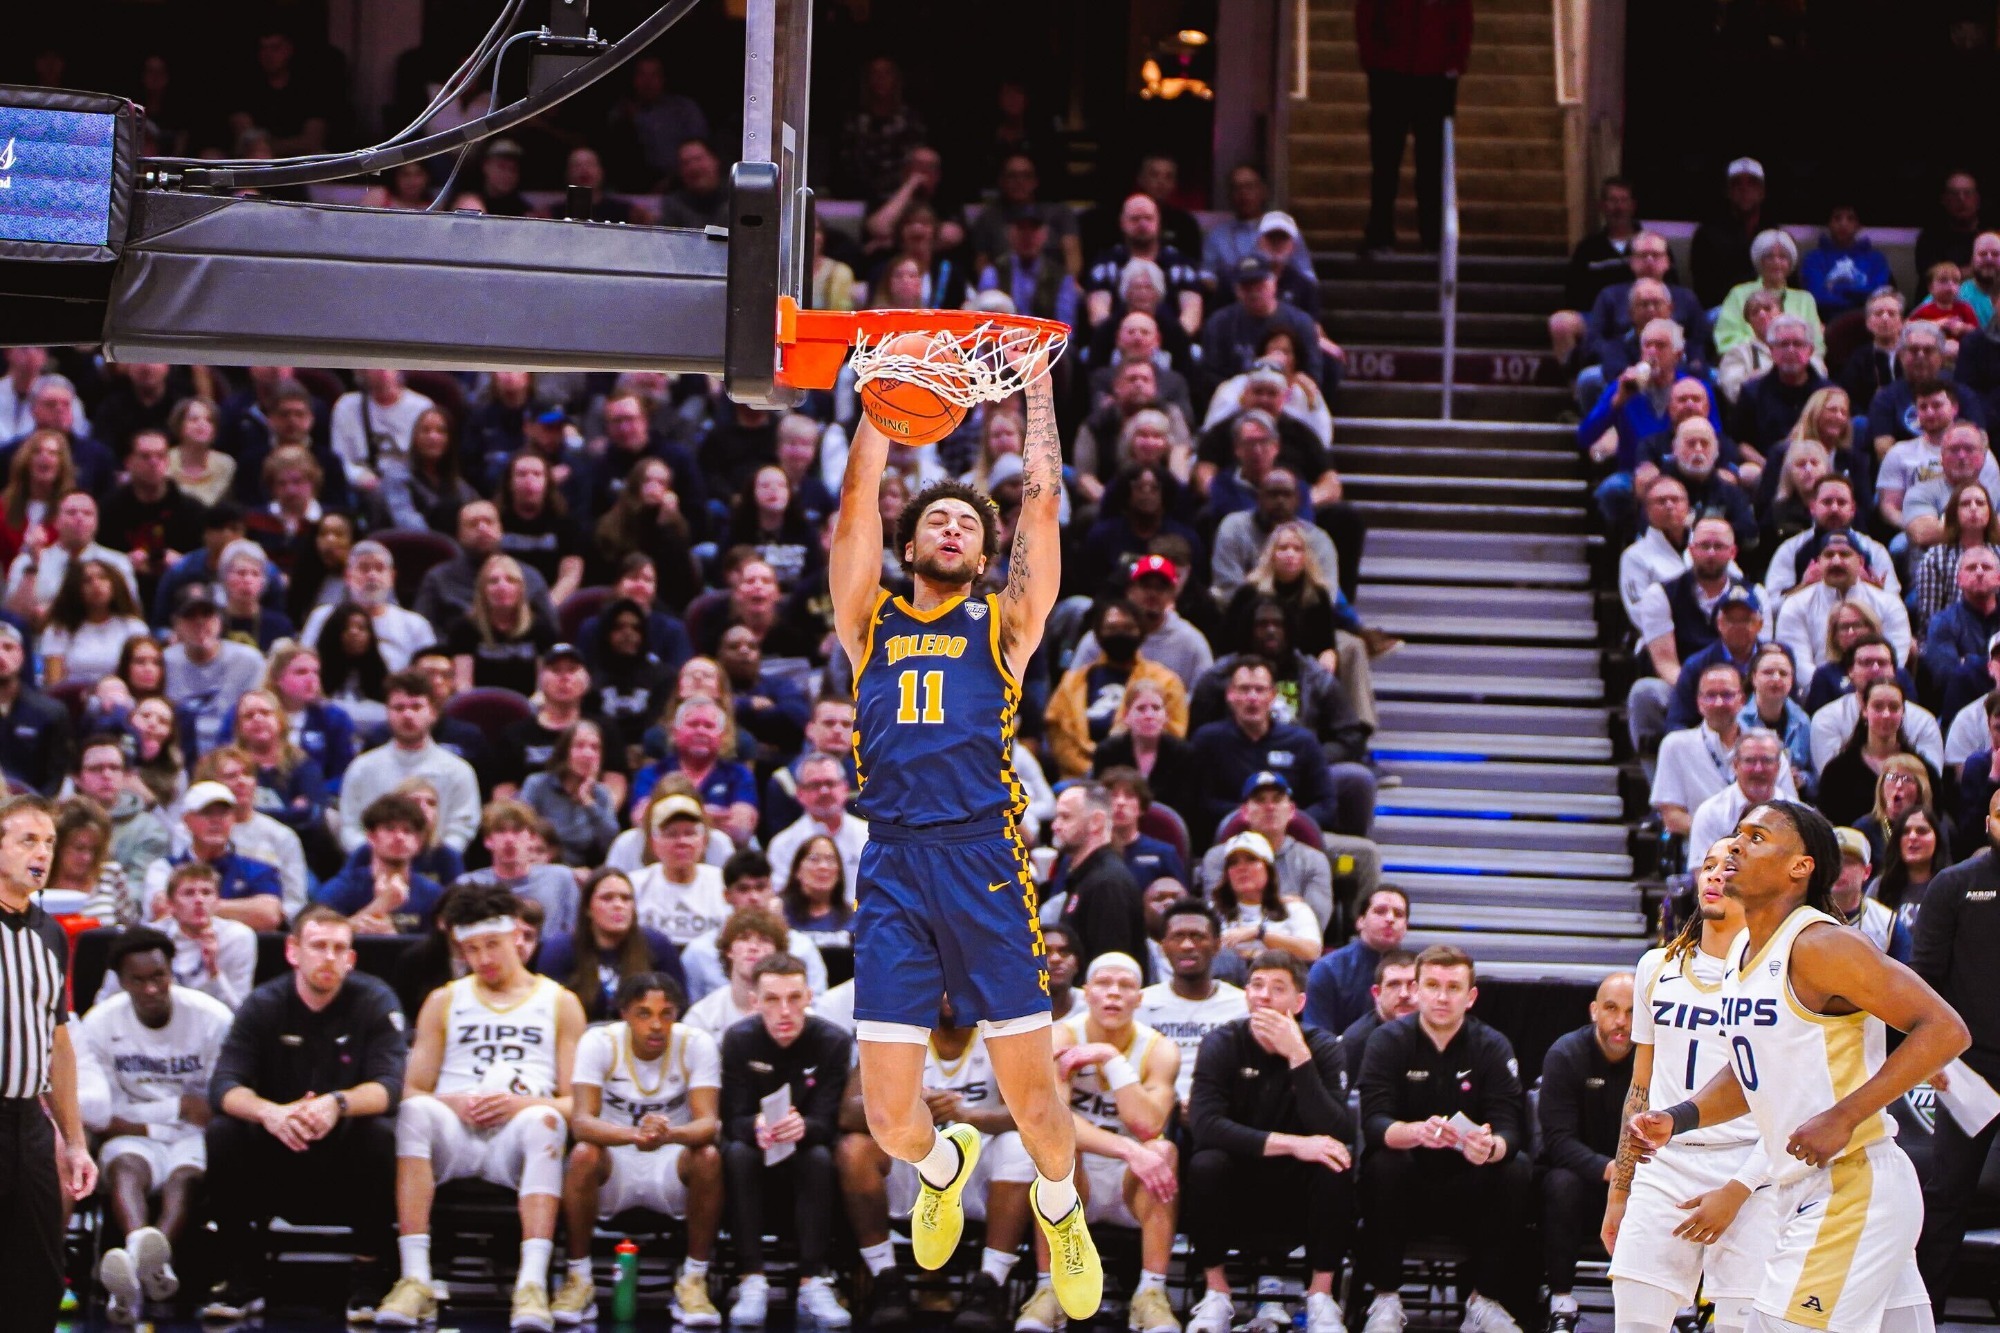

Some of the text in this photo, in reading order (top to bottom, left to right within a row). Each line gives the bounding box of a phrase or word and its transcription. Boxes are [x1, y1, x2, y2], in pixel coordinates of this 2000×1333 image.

[1349, 353, 1395, 377] 106
[1494, 357, 1540, 380] 107
[862, 401, 909, 435] ALDING
[885, 634, 968, 666] TOLEDO
[897, 669, 945, 724] 11
[1966, 890, 1997, 899] AKRON
[1652, 1000, 1726, 1037] ZIP
[457, 1024, 543, 1045] ZIPS
[1685, 1038, 1699, 1091] 1
[1732, 1035, 1759, 1091] 0
[1071, 1087, 1119, 1117] ZIP
[1801, 1295, 1824, 1312] A
